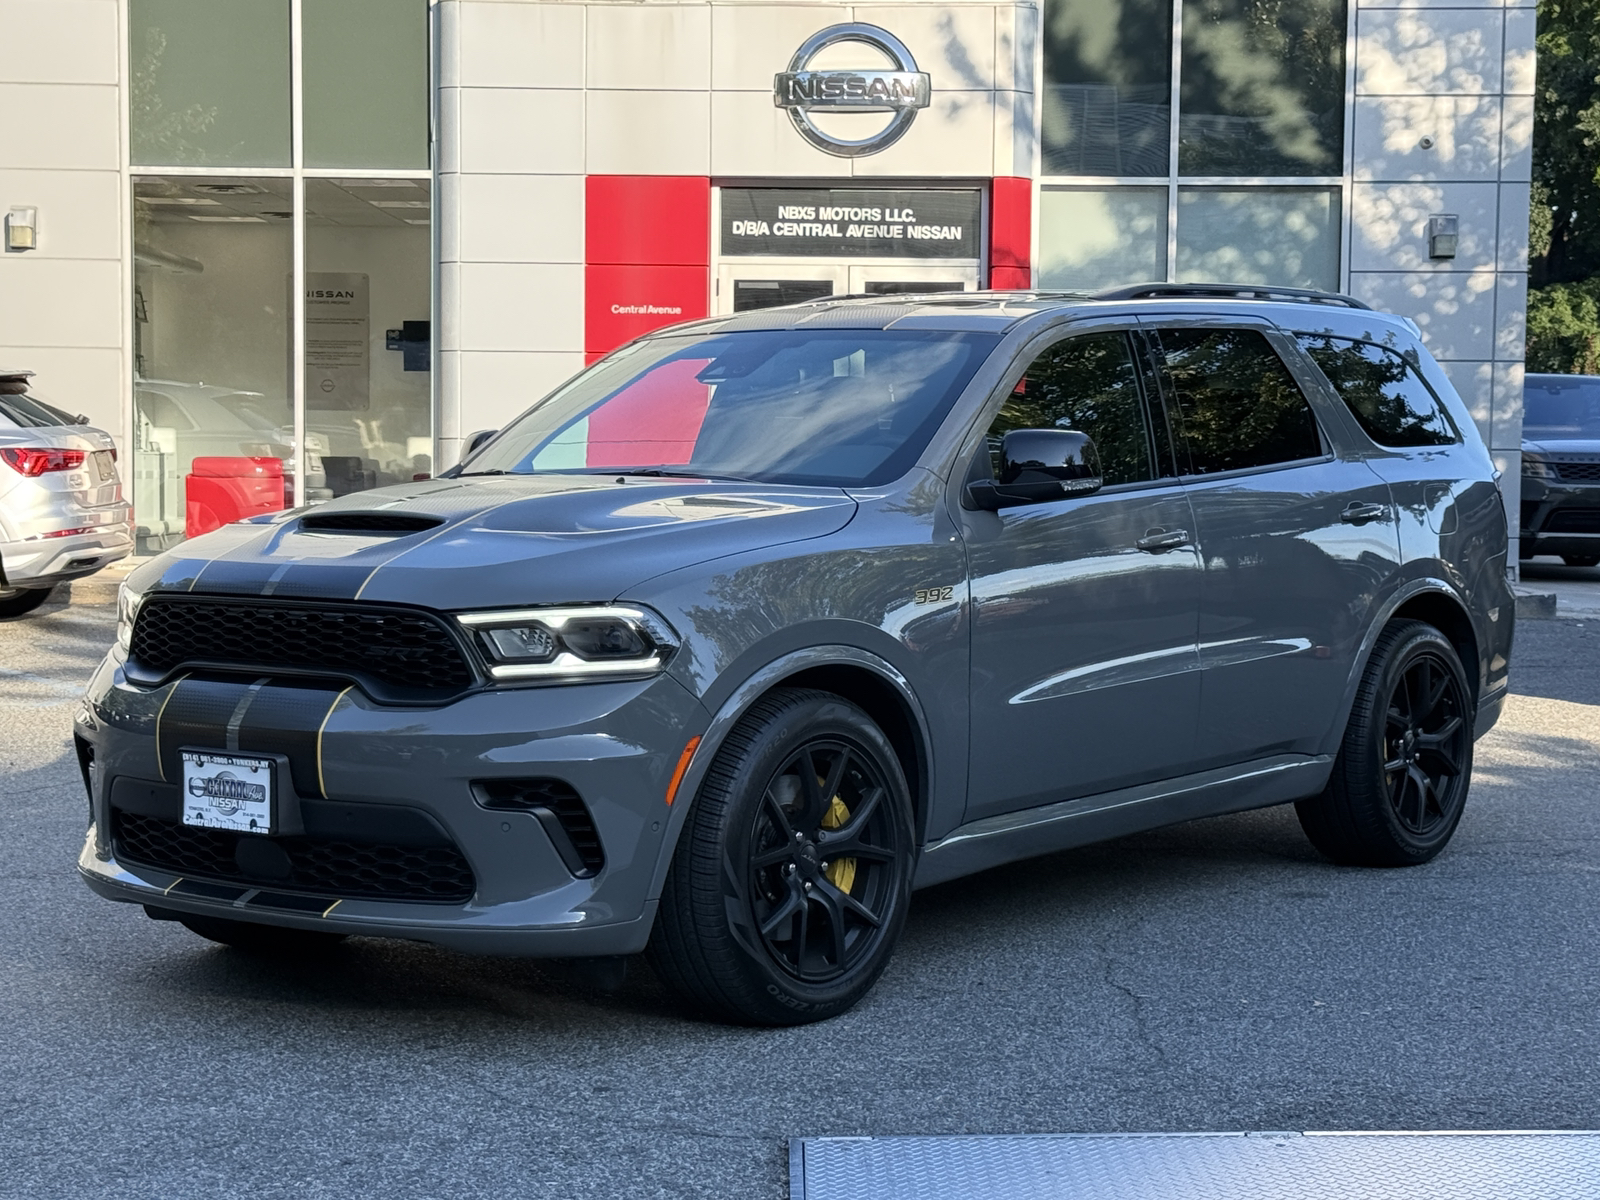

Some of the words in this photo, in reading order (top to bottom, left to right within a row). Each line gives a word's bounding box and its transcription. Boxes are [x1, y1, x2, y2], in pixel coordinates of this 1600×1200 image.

[788, 77, 916, 101] NISSAN
[778, 206, 816, 220] NBX5
[819, 207, 882, 221] MOTORS
[885, 209, 916, 222] LLC.
[732, 221, 770, 236] D/B/A
[773, 223, 842, 237] CENTRAL
[846, 224, 903, 238] AVENUE
[907, 225, 962, 240] NISSAN
[611, 304, 646, 314] Central
[647, 305, 682, 315] Avenue
[915, 585, 954, 606] 392
[208, 797, 246, 811] NISSAN
